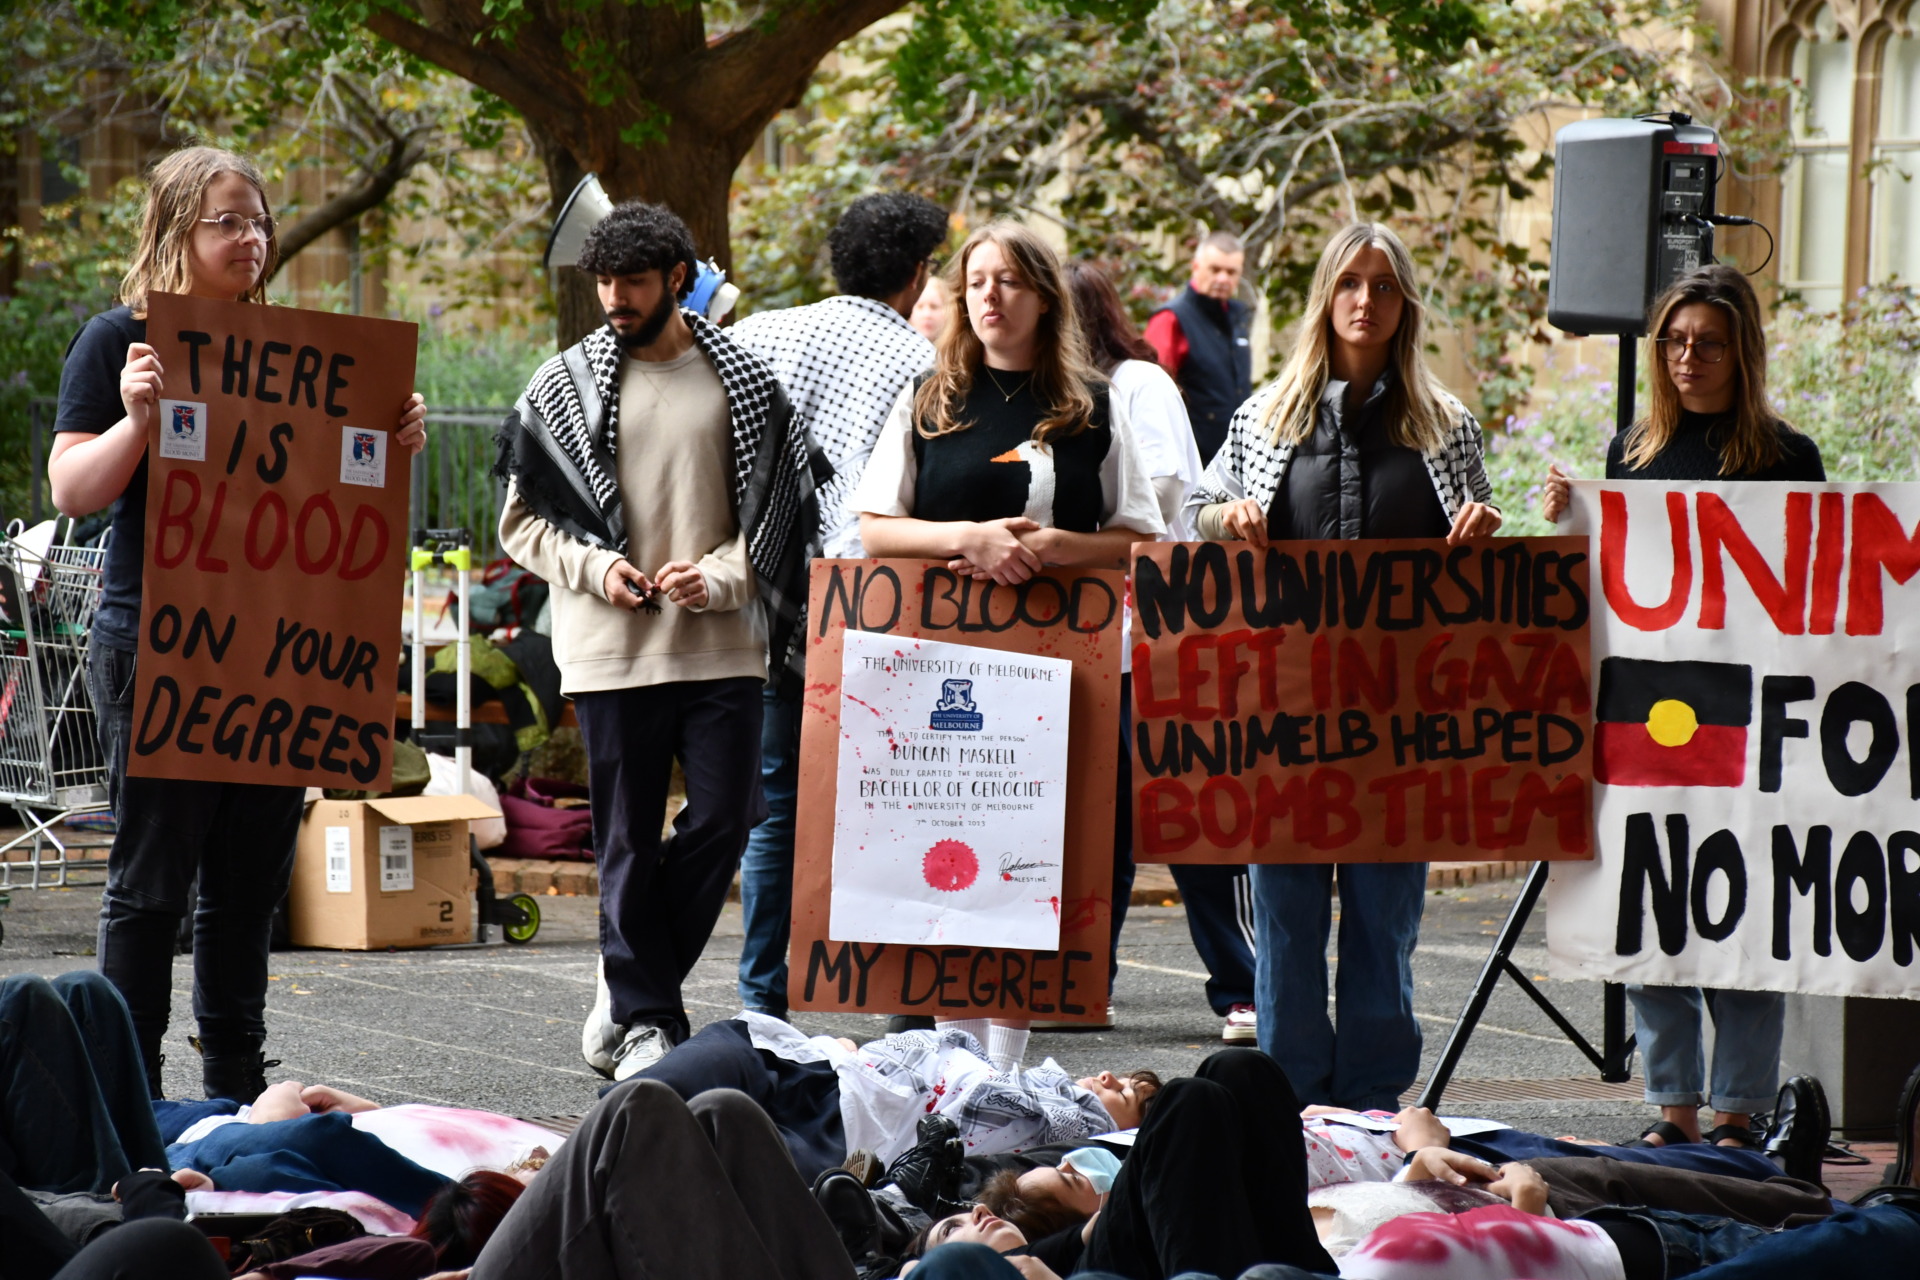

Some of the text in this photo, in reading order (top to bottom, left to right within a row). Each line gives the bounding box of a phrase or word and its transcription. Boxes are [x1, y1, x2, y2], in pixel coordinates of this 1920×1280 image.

[178, 330, 356, 418] THERE
[225, 419, 294, 484] IS
[154, 469, 390, 581] BLOOD
[820, 565, 1117, 637] NO BLOOD
[1135, 542, 1589, 640] NO UNIVERSITIES
[150, 604, 379, 693] ON YOUR
[861, 656, 1055, 682] THE UNIVERSITY OF MELBOURNE
[1132, 628, 1591, 721] LEFT IN GAZA
[135, 675, 389, 783] DEGREES
[893, 745, 1017, 764] DUNCAN MASKELL
[921, 733, 952, 741] CERTIFY
[1000, 735, 1025, 743] PERSON
[1137, 708, 1585, 777] UNIMELB HELPED
[860, 780, 1045, 798] BACHELOR OF GENOCIDE
[864, 768, 881, 776] WAS
[890, 769, 910, 777] DULY
[976, 770, 1003, 778] DEGREE
[882, 801, 902, 810] THE
[913, 802, 966, 811] UNIVERSITY
[971, 803, 982, 811] OF
[987, 803, 1035, 811] MELBOURNE
[931, 819, 964, 827] OCTOBER
[1140, 765, 1589, 855] BOMB THEM
[440, 900, 453, 922] 2
[1615, 812, 1748, 956] NO
[803, 939, 1093, 1014] MY DEGREE
